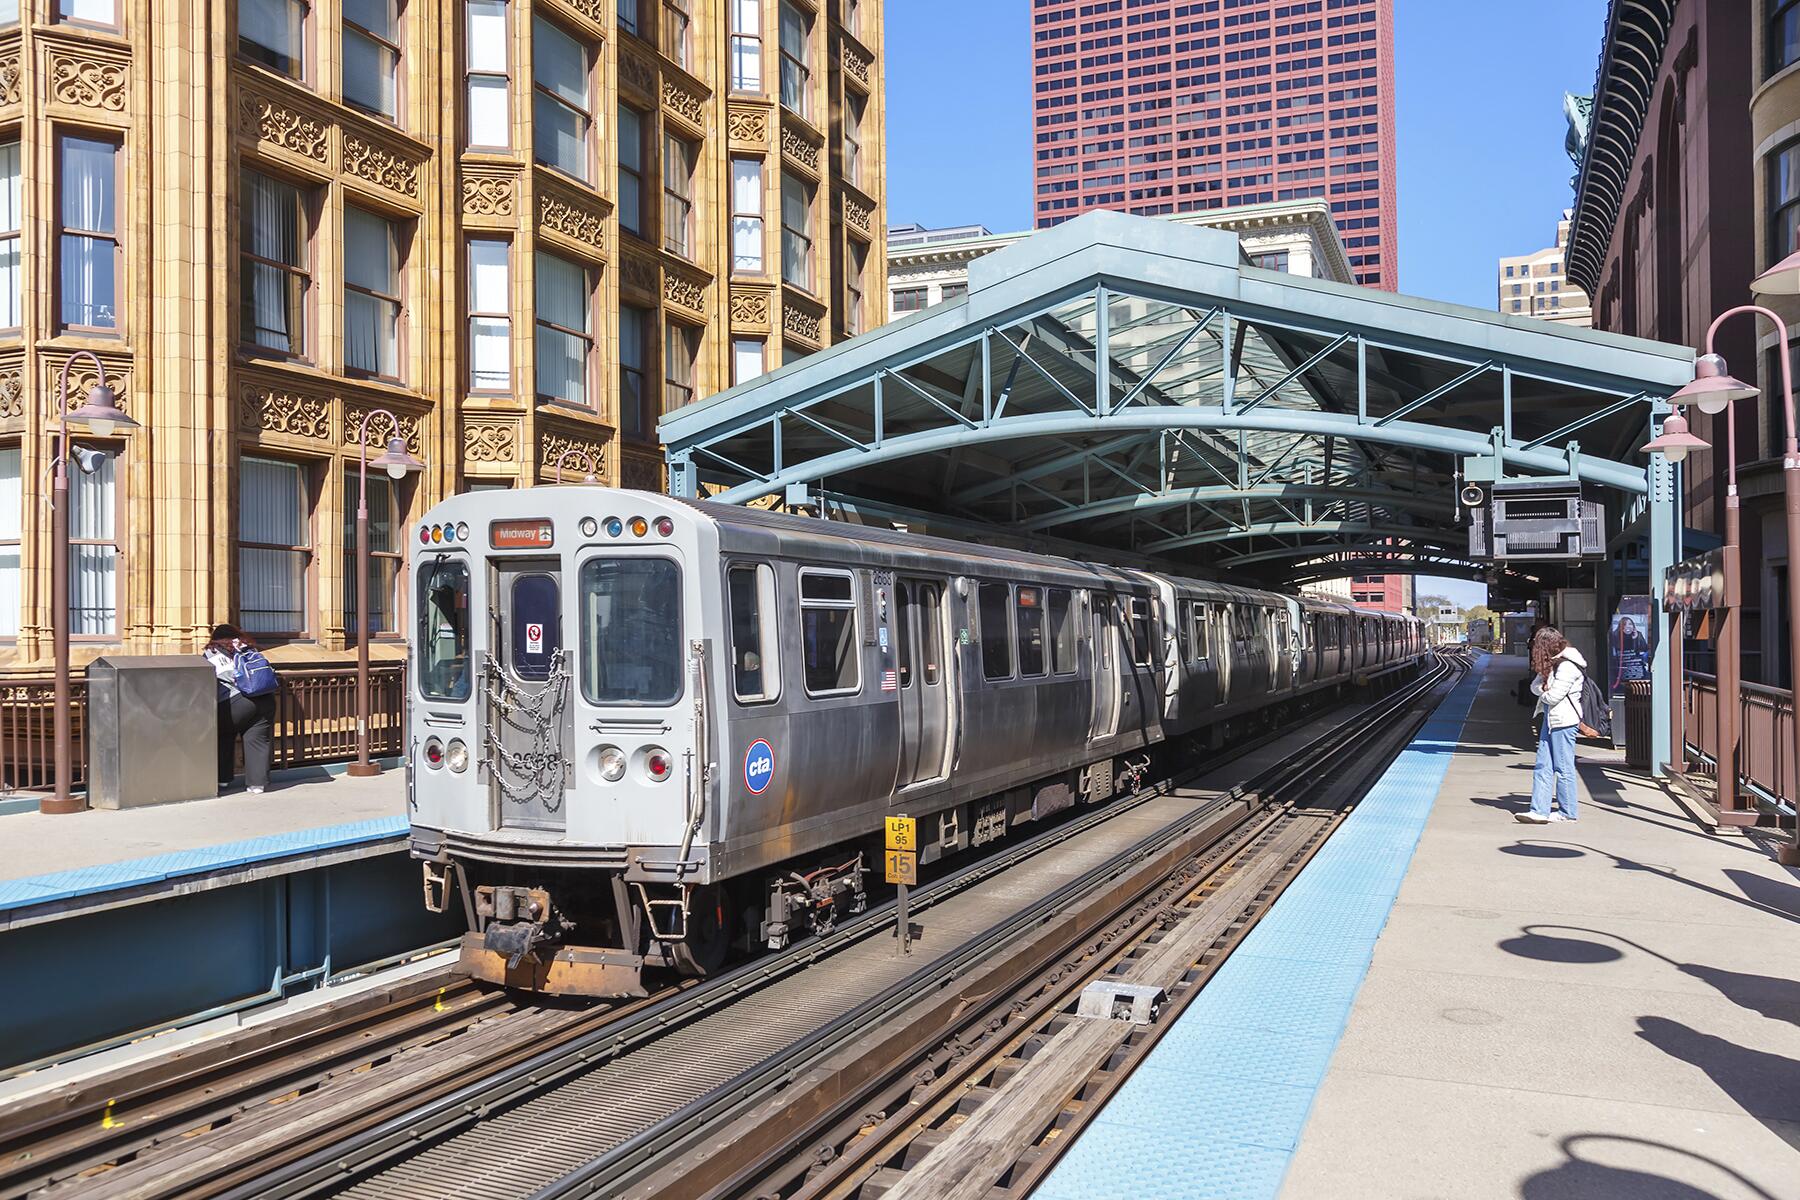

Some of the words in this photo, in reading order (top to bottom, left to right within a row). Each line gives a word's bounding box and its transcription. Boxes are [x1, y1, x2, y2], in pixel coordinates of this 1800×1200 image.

[500, 527, 536, 540] Midway
[749, 756, 770, 777] cta
[891, 822, 910, 833] LP1
[895, 835, 908, 845] 95
[890, 855, 911, 875] 15
